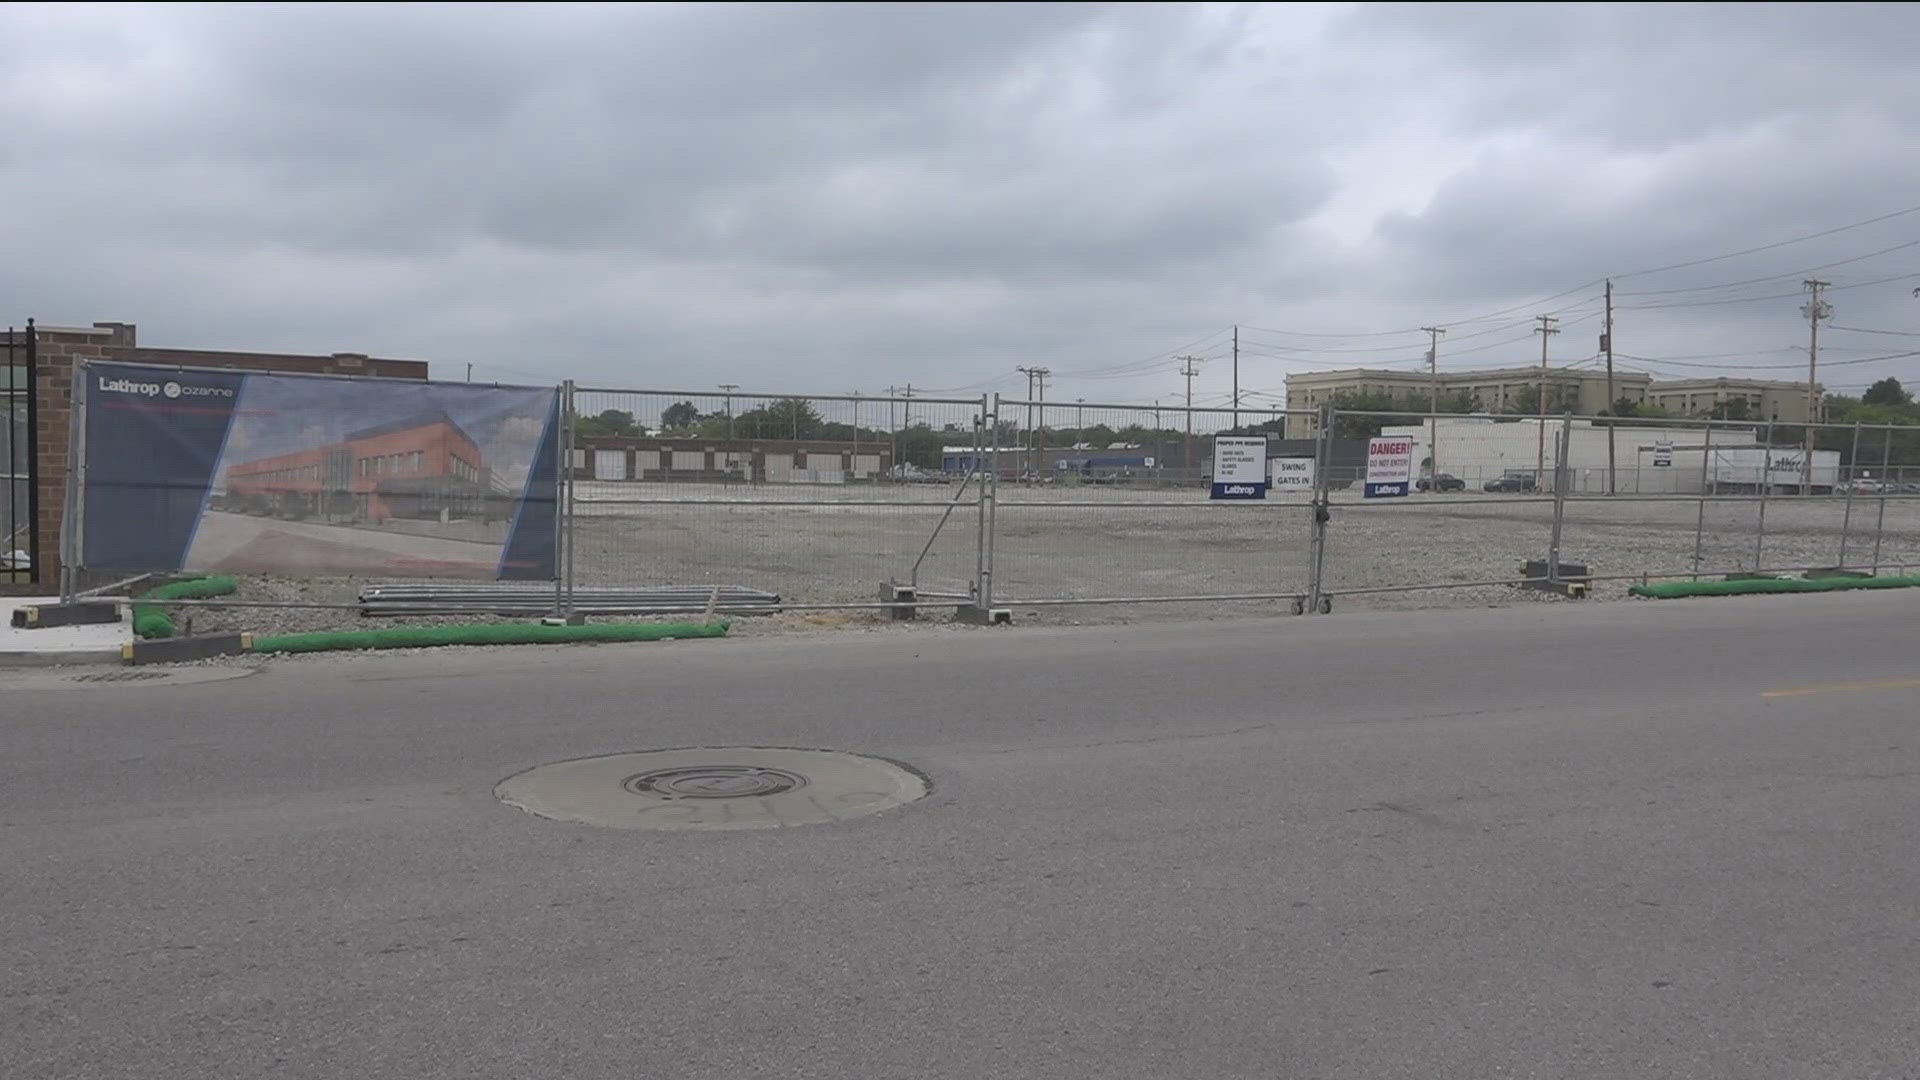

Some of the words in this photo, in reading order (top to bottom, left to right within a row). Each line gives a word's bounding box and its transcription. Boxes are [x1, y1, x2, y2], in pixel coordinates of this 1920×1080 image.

[99, 377, 160, 396] Lathrop
[1370, 442, 1410, 454] DANGER!
[1281, 463, 1306, 472] SWING
[1224, 485, 1254, 495] Lathrop
[1375, 485, 1400, 494] Lathrop
